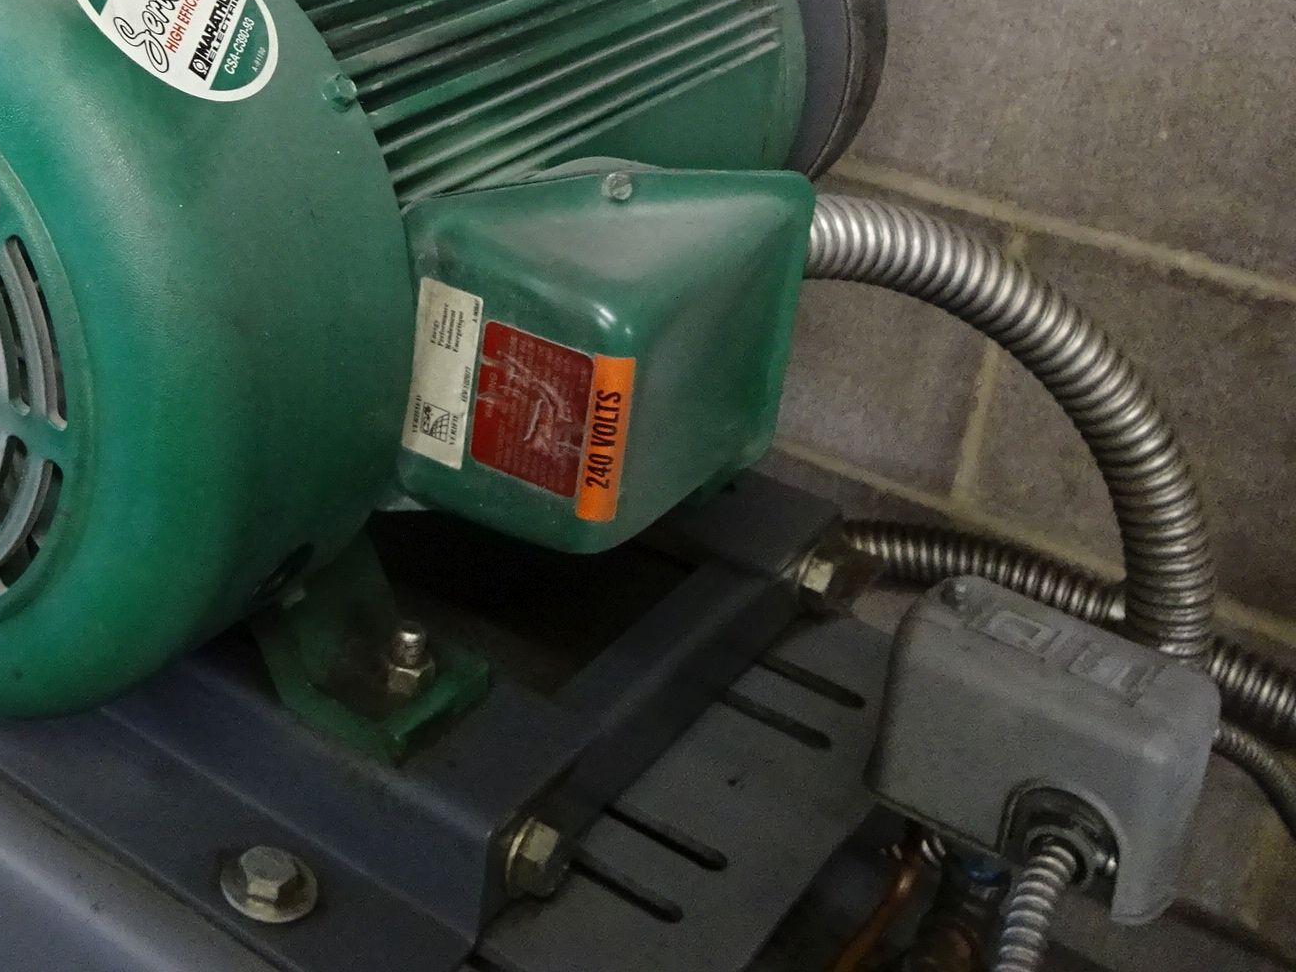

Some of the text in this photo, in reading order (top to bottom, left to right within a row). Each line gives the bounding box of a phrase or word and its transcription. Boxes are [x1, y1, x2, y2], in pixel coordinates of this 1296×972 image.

[164, 22, 187, 54] HIGH
[223, 15, 256, 75] CSA-C390-93
[585, 388, 622, 491] 240 VOLTS
